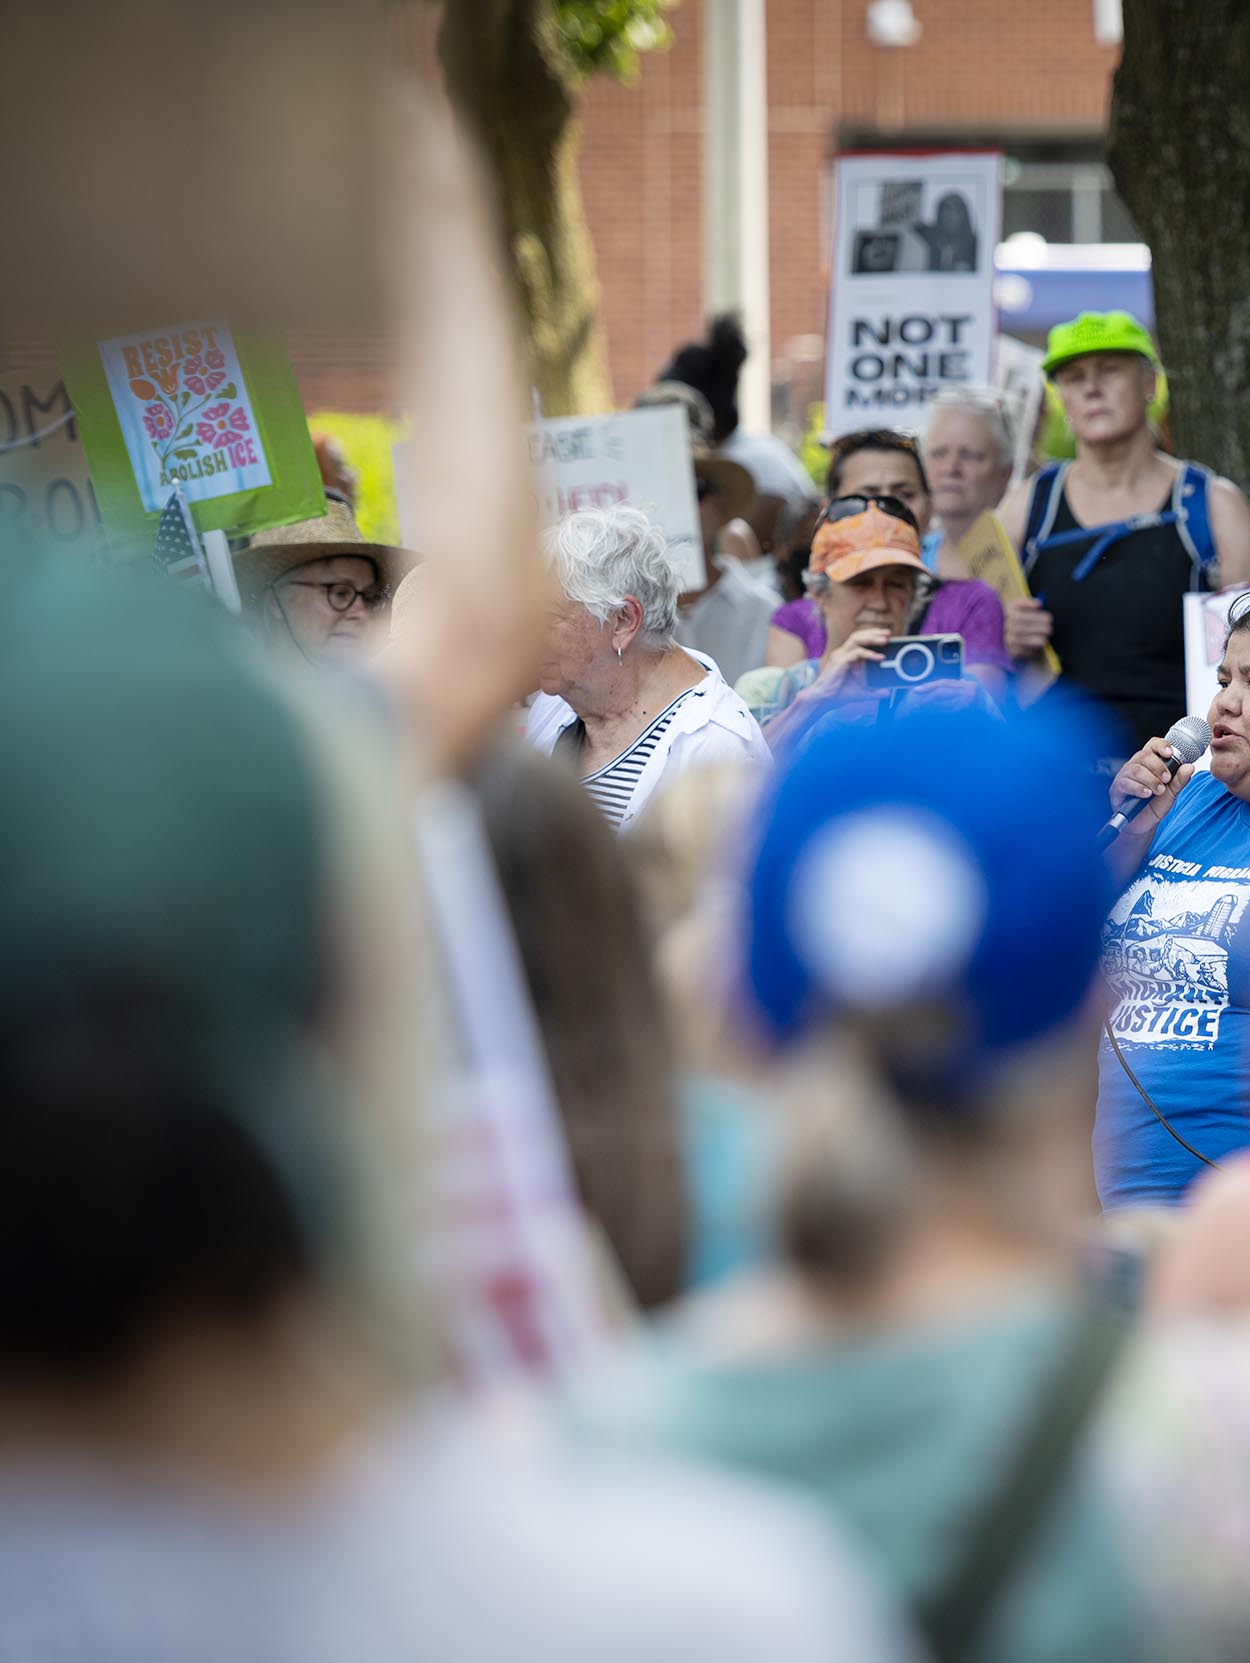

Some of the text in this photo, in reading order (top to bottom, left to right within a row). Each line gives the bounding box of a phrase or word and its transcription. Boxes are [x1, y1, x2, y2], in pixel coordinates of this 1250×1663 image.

[852, 315, 972, 347] NOT
[121, 325, 219, 378] RESIST
[850, 352, 967, 382] ONE
[159, 438, 258, 486] ABOLISH ICE
[1112, 1004, 1218, 1037] USTICE
